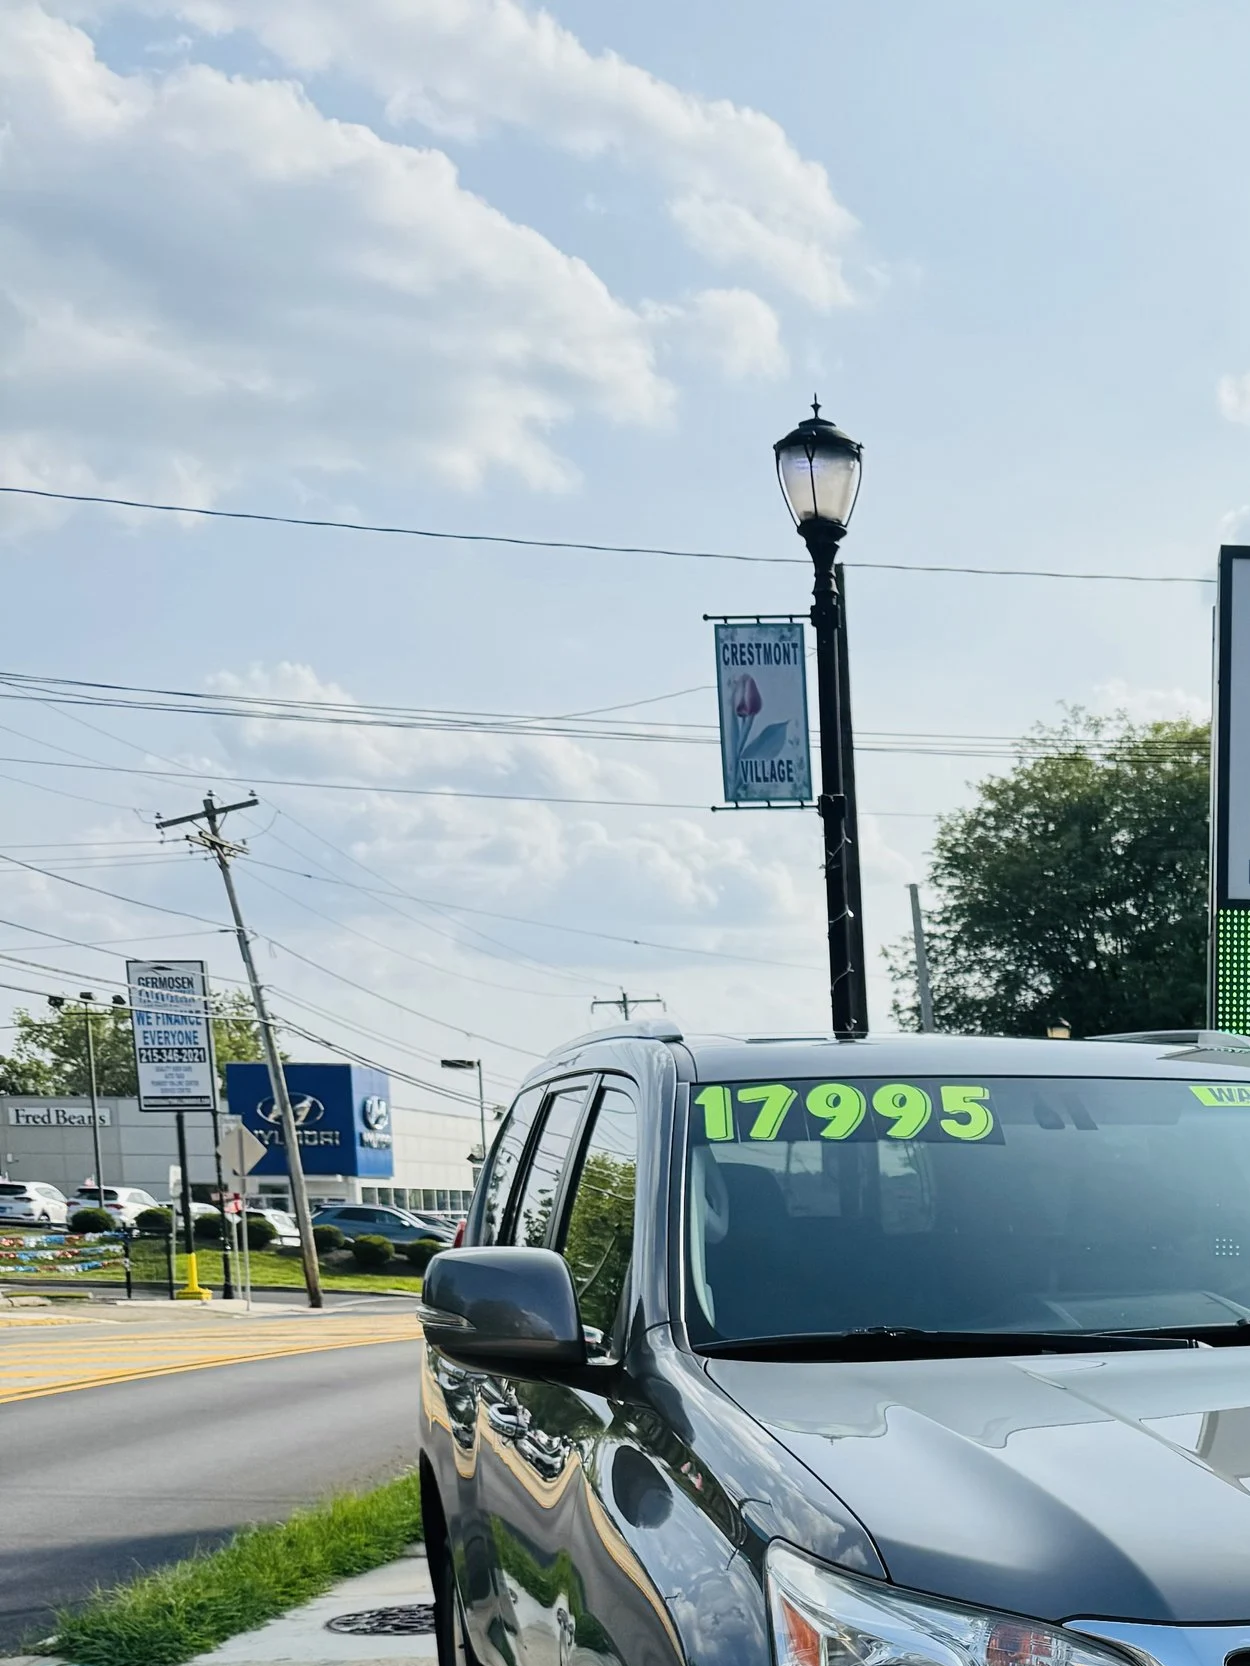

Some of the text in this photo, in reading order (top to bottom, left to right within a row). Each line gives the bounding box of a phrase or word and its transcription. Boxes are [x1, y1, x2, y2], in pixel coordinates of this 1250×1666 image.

[722, 642, 800, 666] CRESTMONT
[740, 759, 795, 784] VILLAGE
[137, 976, 194, 989] GERMOSEN
[135, 1010, 202, 1026] WE FINANCE
[142, 1030, 199, 1046] EVERYONE
[140, 1048, 205, 1063] 215-346-2021
[14, 1108, 51, 1125] Fred
[694, 1083, 994, 1141] 17995
[254, 1129, 340, 1146] YUDAI
